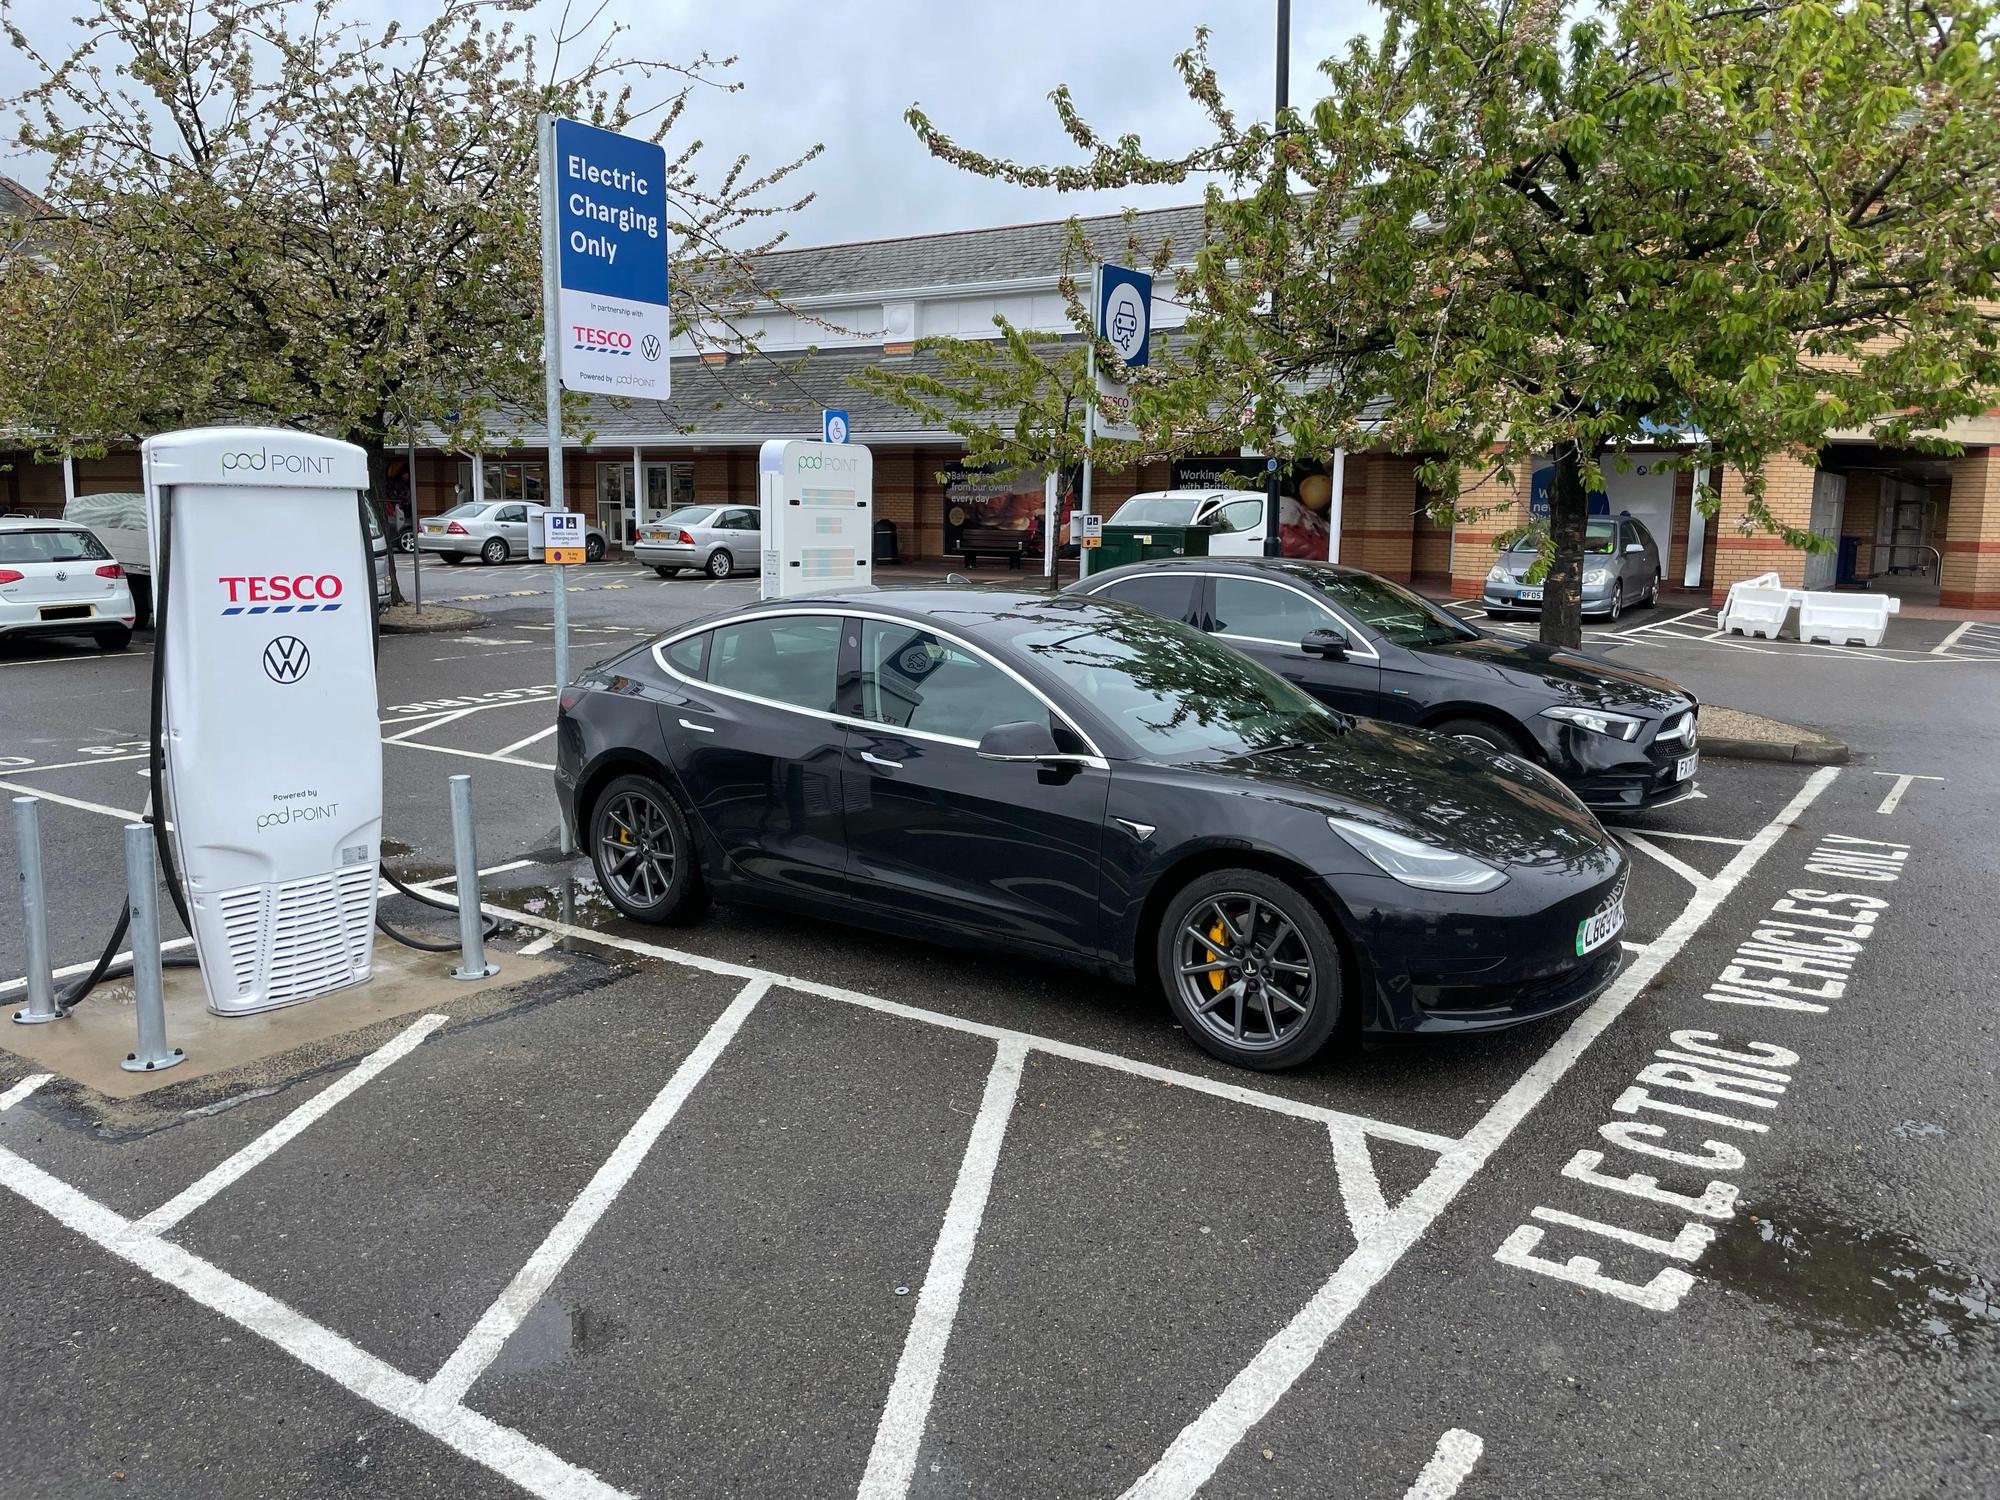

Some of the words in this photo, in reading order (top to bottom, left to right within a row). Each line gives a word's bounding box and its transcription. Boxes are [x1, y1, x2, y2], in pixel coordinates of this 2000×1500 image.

[568, 154, 649, 196] Electric
[569, 193, 658, 239] Charging
[570, 231, 617, 265] Only
[590, 303, 597, 311] In
[598, 304, 630, 317] partnership
[631, 308, 644, 318] with
[573, 326, 632, 348] TESCO
[580, 371, 605, 383] Powered
[606, 373, 613, 384] by
[616, 373, 633, 386] pod
[633, 377, 656, 388] POINT
[221, 446, 267, 478] pod
[271, 453, 335, 475] POINT
[798, 451, 823, 475] pod
[824, 457, 859, 473] POINT
[951, 471, 979, 482] Baki
[951, 481, 971, 491] from
[988, 483, 1013, 491] ovens
[1180, 469, 1220, 482] Working
[1180, 481, 1201, 490] with
[951, 494, 974, 505] every
[975, 493, 990, 505] day
[218, 574, 343, 602] TESCO
[272, 790, 305, 803] Powered
[306, 789, 318, 799] by
[256, 805, 290, 834] pod
[293, 803, 339, 823] POINT
[1492, 1029, 1800, 1313] ELECTRIC
[1702, 887, 1890, 1014] VEHICLES
[1803, 833, 1911, 882] ONLY
